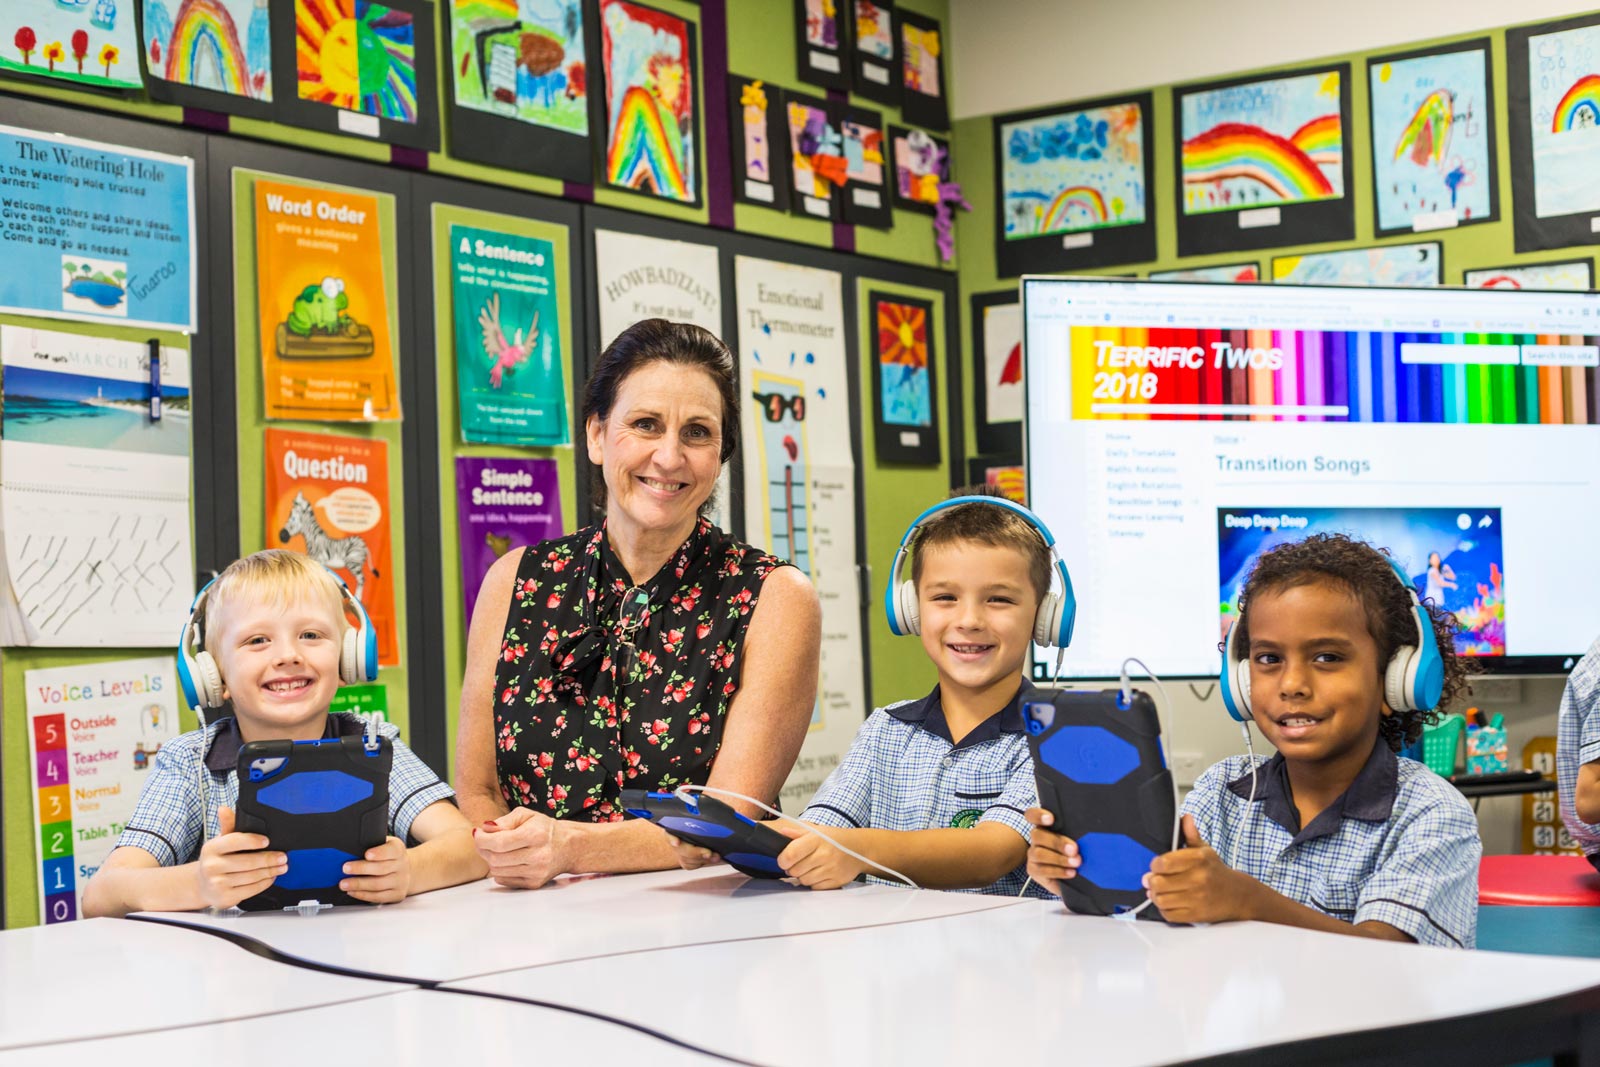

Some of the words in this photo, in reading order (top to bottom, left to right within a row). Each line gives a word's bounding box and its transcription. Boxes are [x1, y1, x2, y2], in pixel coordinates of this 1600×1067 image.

[16, 140, 48, 161] The
[52, 147, 125, 178] Watering
[130, 161, 165, 182] Hole
[1, 177, 40, 189] arners:
[9, 166, 27, 177] the
[31, 169, 79, 187] Watering
[83, 178, 104, 190] Hole
[109, 182, 146, 196] trusted
[2, 197, 51, 213] Welcome
[56, 206, 89, 219] others
[93, 212, 110, 222] and
[114, 215, 141, 227] share
[266, 193, 312, 217] Word
[316, 201, 366, 225] Order
[2, 208, 26, 220] Give
[31, 213, 56, 224] each
[60, 217, 87, 230] other
[91, 223, 130, 237] support
[133, 229, 150, 239] and
[8, 221, 33, 232] each
[37, 226, 69, 238] other.
[3, 230, 33, 244] Come
[37, 236, 56, 247] and
[60, 241, 73, 251] go
[78, 243, 87, 251] as
[460, 237, 472, 255] A
[475, 239, 545, 267] Sentence
[758, 283, 824, 311] Emotional
[1093, 340, 1204, 369] TERRIFIC
[1092, 372, 1158, 399] 2018
[283, 450, 368, 483] Question
[1216, 455, 1307, 471] Transition
[1314, 455, 1371, 476] Songs
[481, 468, 533, 490] Simple
[472, 487, 544, 506] Sentence
[38, 683, 93, 704] Voice
[100, 674, 163, 697] Levels
[70, 715, 117, 731] Outside
[45, 724, 58, 744] 5
[72, 733, 96, 742] Voice
[72, 750, 119, 765] Teacher
[46, 760, 59, 781] 4
[74, 767, 98, 777] Voice
[75, 783, 121, 800] Normal
[48, 796, 62, 816] 3
[77, 802, 100, 812] Voice
[77, 826, 108, 841] Table
[110, 821, 128, 835] Ta
[51, 832, 65, 853] 2
[54, 867, 65, 889] 1
[53, 900, 69, 921] 0
